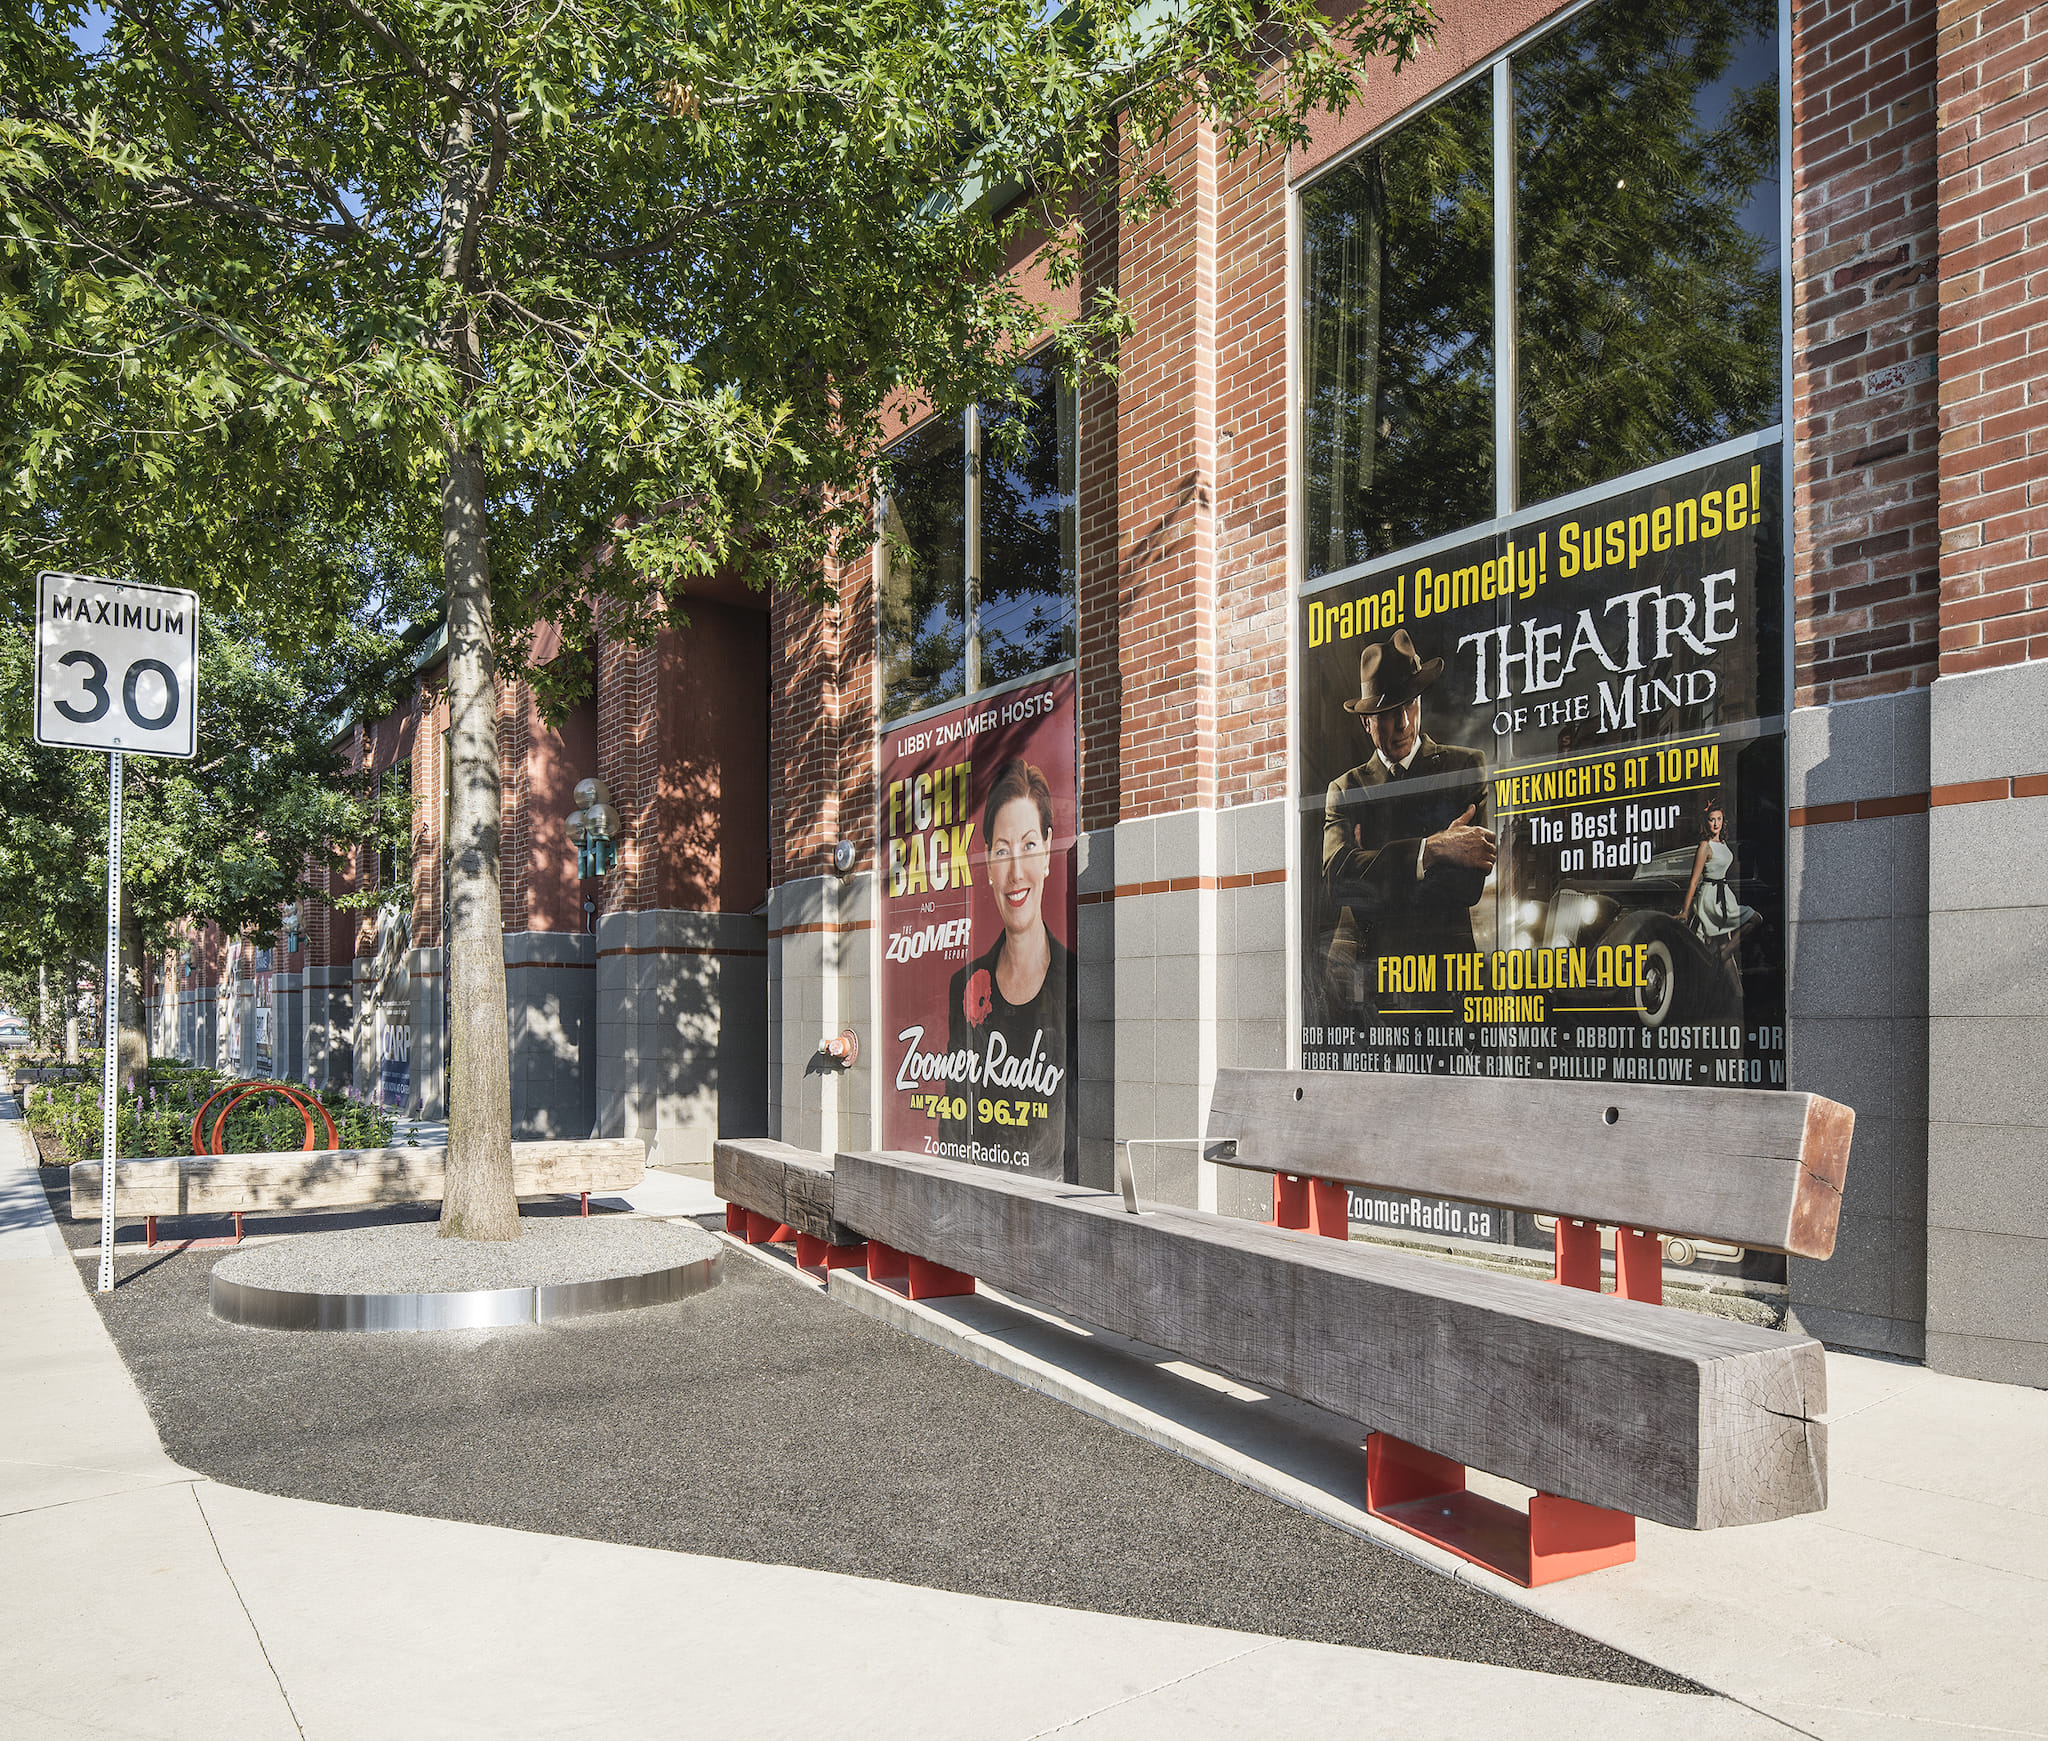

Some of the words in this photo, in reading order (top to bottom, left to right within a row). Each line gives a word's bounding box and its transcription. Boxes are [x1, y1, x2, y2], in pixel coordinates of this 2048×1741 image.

[1308, 575, 1405, 649] Drama!
[1414, 531, 1547, 619] Comedy!
[1559, 464, 1762, 578] Suspense!
[53, 594, 184, 635] MAXIMUM
[1456, 568, 1738, 705] THEATRE
[53, 650, 180, 731] 30
[1492, 706, 1528, 736] OF
[1534, 694, 1590, 729] THE
[1595, 669, 1718, 735] MIND
[898, 730, 932, 758] LIBBY
[936, 711, 997, 746] ZNAIMER
[1001, 692, 1054, 726] HOSTS
[889, 761, 972, 837] FIGHT
[1495, 761, 1616, 808] WEEKNIGHTS
[1624, 756, 1649, 789] AT
[1529, 817, 1564, 845] The
[1571, 807, 1617, 841] Best
[1625, 804, 1681, 835] Hour
[889, 823, 975, 898] BACK
[1560, 848, 1584, 873] on
[1592, 837, 1652, 869] Radio
[920, 902, 935, 913] AND
[886, 918, 971, 963] ZOOMER
[1378, 954, 1437, 993] FROM
[1443, 952, 1484, 992] THE
[1492, 947, 1587, 990] GOLDEN
[1596, 943, 1648, 988] AGE
[1464, 995, 1545, 1023] STARRING
[896, 1025, 982, 1091] Zoomer
[982, 1029, 1065, 1096] Radio
[1302, 1027, 1323, 1045] BOB
[1327, 1027, 1355, 1046] HOPE
[1369, 1027, 1410, 1046] BURNS
[1414, 1027, 1423, 1046] &
[1427, 1027, 1464, 1047] ALLEN
[1481, 1027, 1557, 1048] GUNSMOKE
[1576, 1026, 1635, 1049] ABBOTT
[1641, 1026, 1652, 1049] &
[1658, 1026, 1741, 1050] COSTELLO
[1302, 1052, 1339, 1071] FIBBER
[1384, 1054, 1392, 1072] &
[1396, 1053, 1434, 1074] MOLLY
[1450, 1055, 1481, 1075] LONE
[1486, 1055, 1531, 1076] RANGE
[1549, 1056, 1607, 1078] PHILLIP
[1613, 1057, 1693, 1081] MARLOWE
[1715, 1059, 1762, 1083] NERO
[910, 1095, 924, 1109] AM
[925, 1095, 967, 1120] 740
[977, 1099, 1030, 1126] 96.7
[1032, 1102, 1048, 1119] FM
[924, 1136, 1030, 1167] ZoomerRadio.ca
